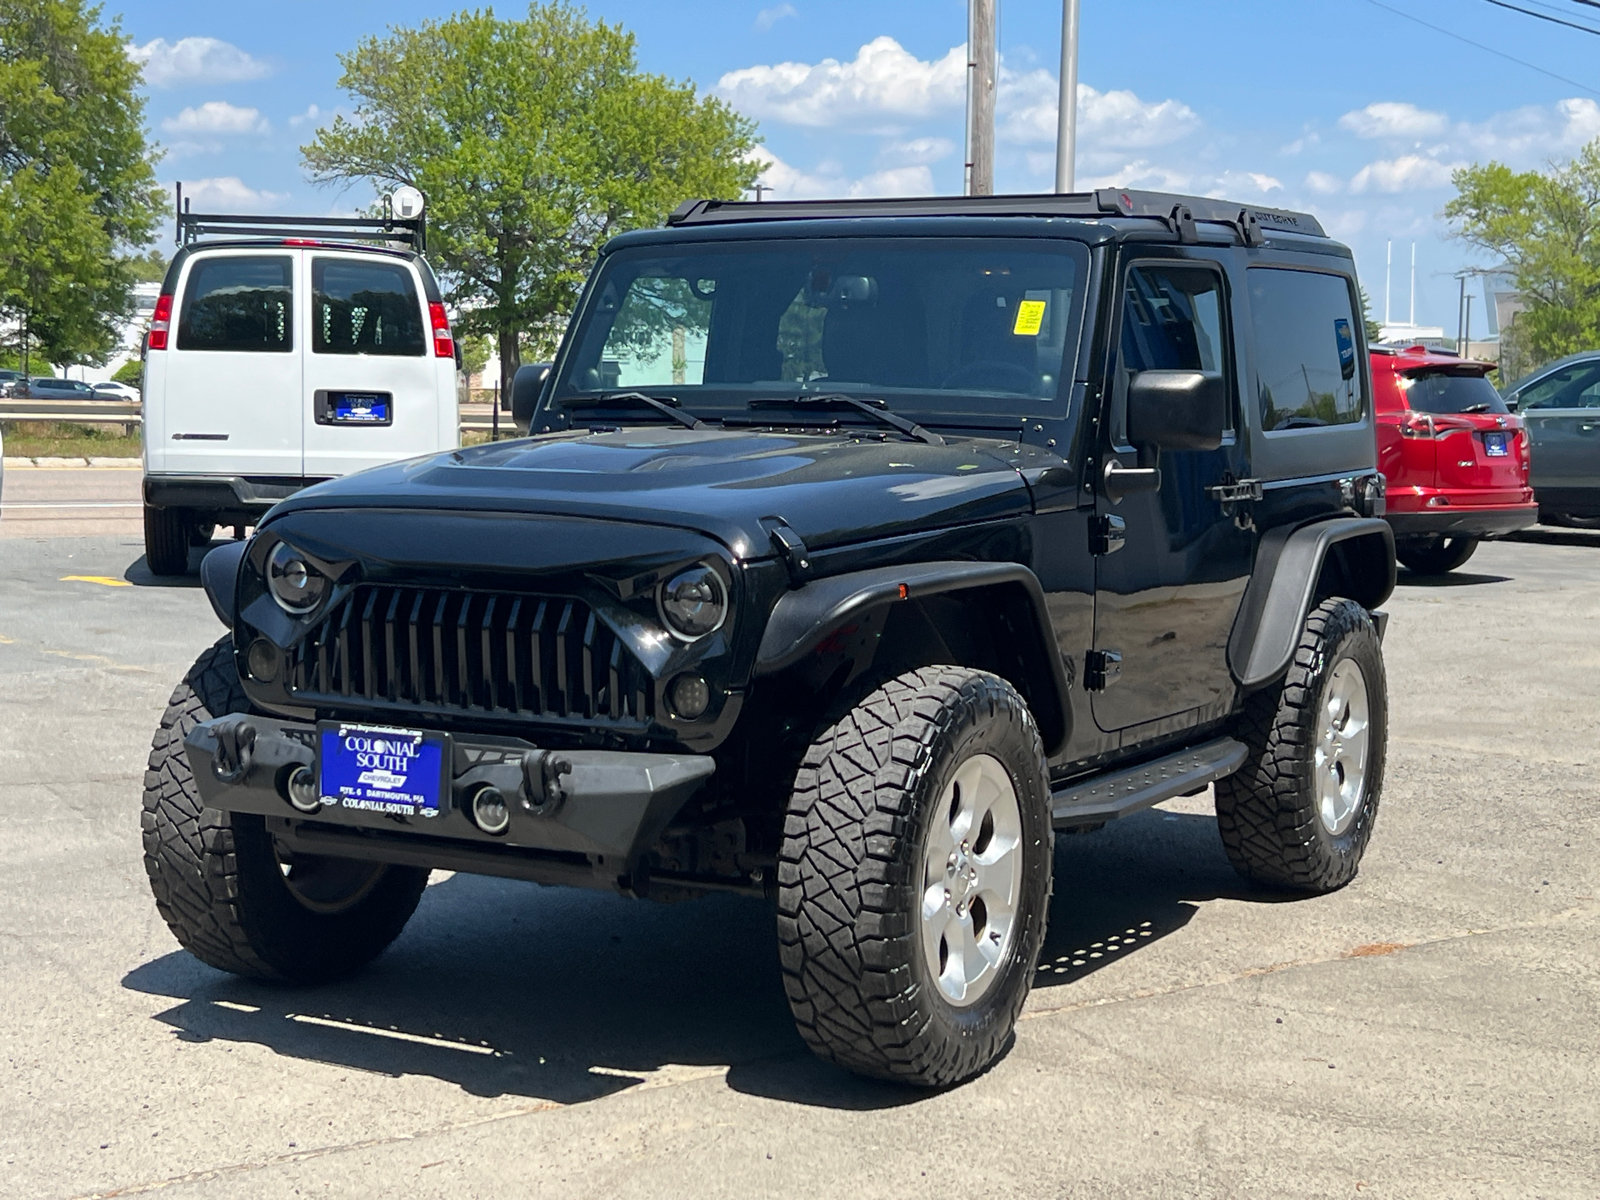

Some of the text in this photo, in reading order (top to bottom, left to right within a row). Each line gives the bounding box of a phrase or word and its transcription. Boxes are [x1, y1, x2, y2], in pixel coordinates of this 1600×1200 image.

[345, 736, 421, 758] COLONIAL
[356, 753, 408, 771] SOUTH
[362, 774, 402, 784] CHEVROLET
[342, 797, 415, 815] COLONIAL SOUTH
